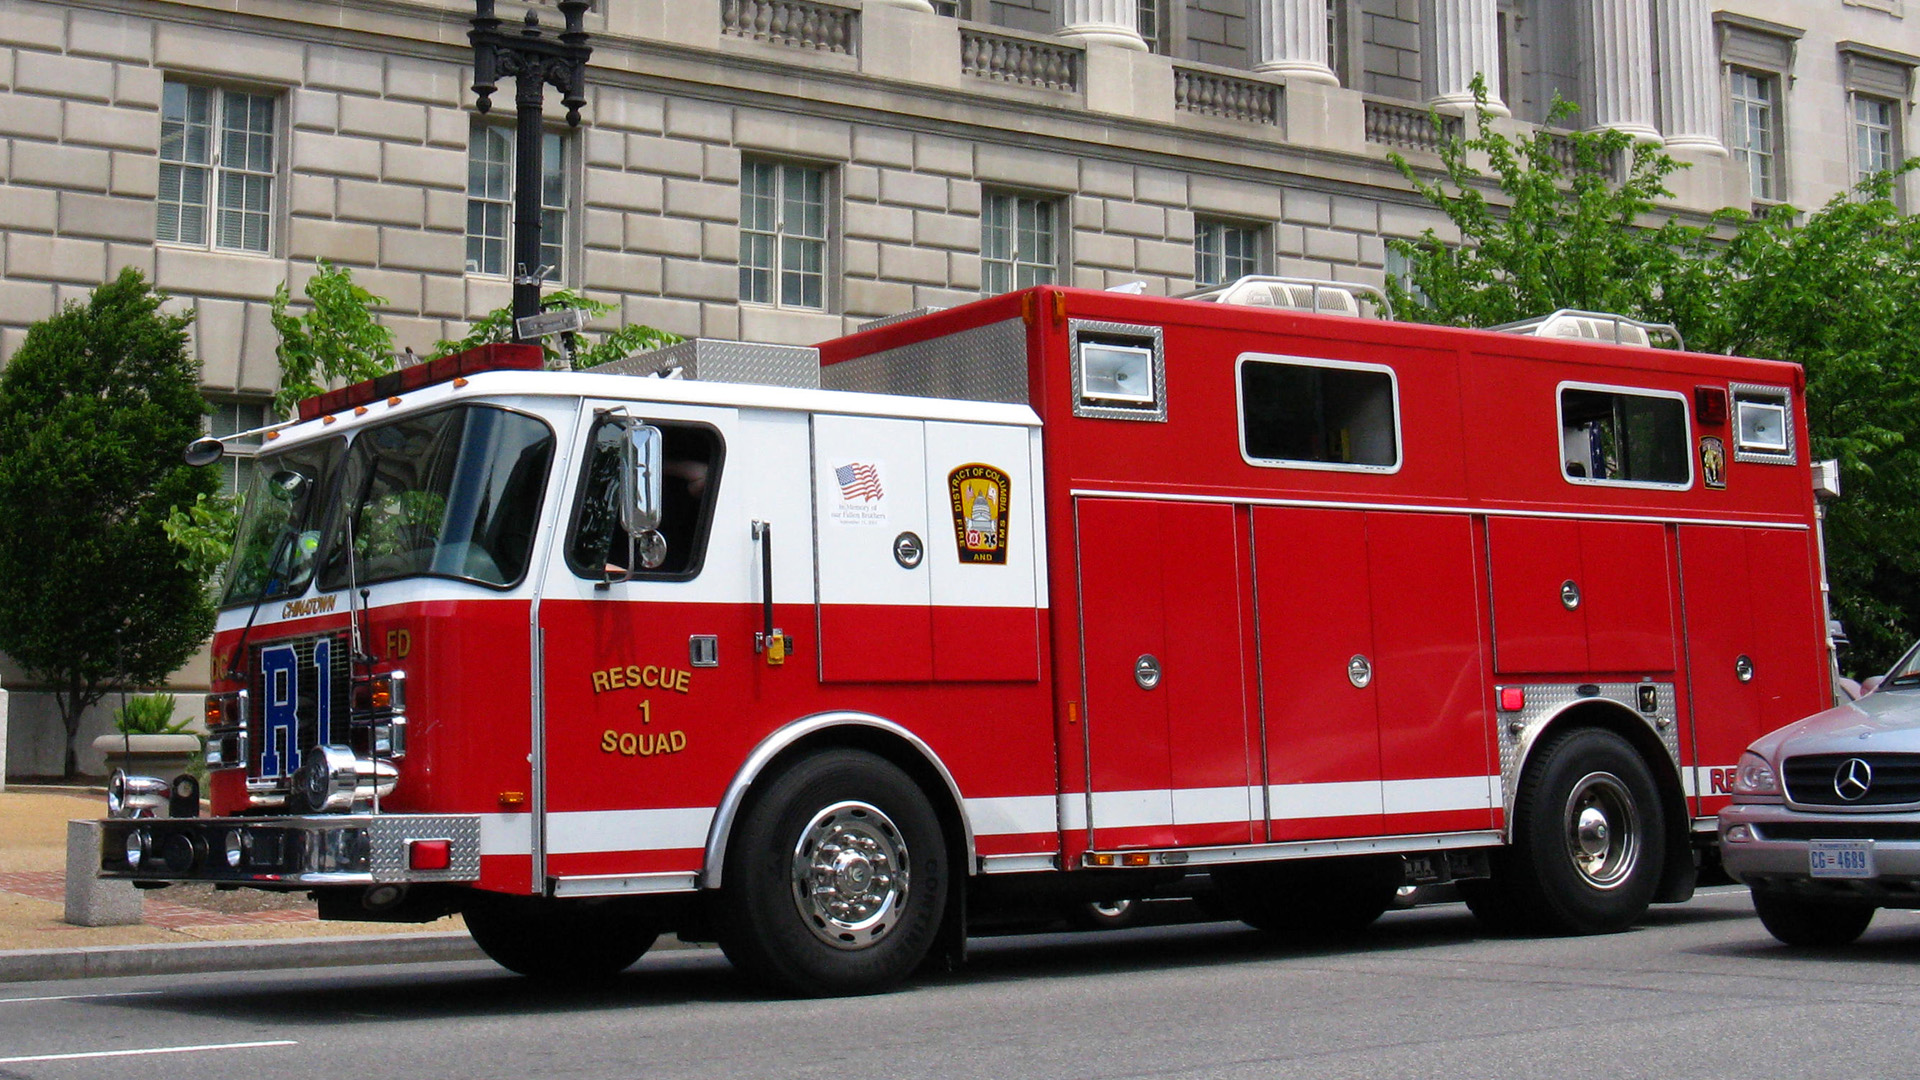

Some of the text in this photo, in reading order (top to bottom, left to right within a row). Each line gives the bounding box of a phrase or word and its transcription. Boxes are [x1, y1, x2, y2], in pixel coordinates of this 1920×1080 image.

[952, 467, 1007, 512] DISTRICT OF COLUMBIA
[958, 519, 966, 547] FIRE
[973, 553, 993, 561] AND
[282, 594, 337, 619] CHINATOWN
[386, 629, 411, 660] FD
[592, 665, 692, 693] RESCUE
[638, 699, 650, 723] 1
[601, 729, 687, 756] SQUAD
[1837, 851, 1865, 868] 4689
